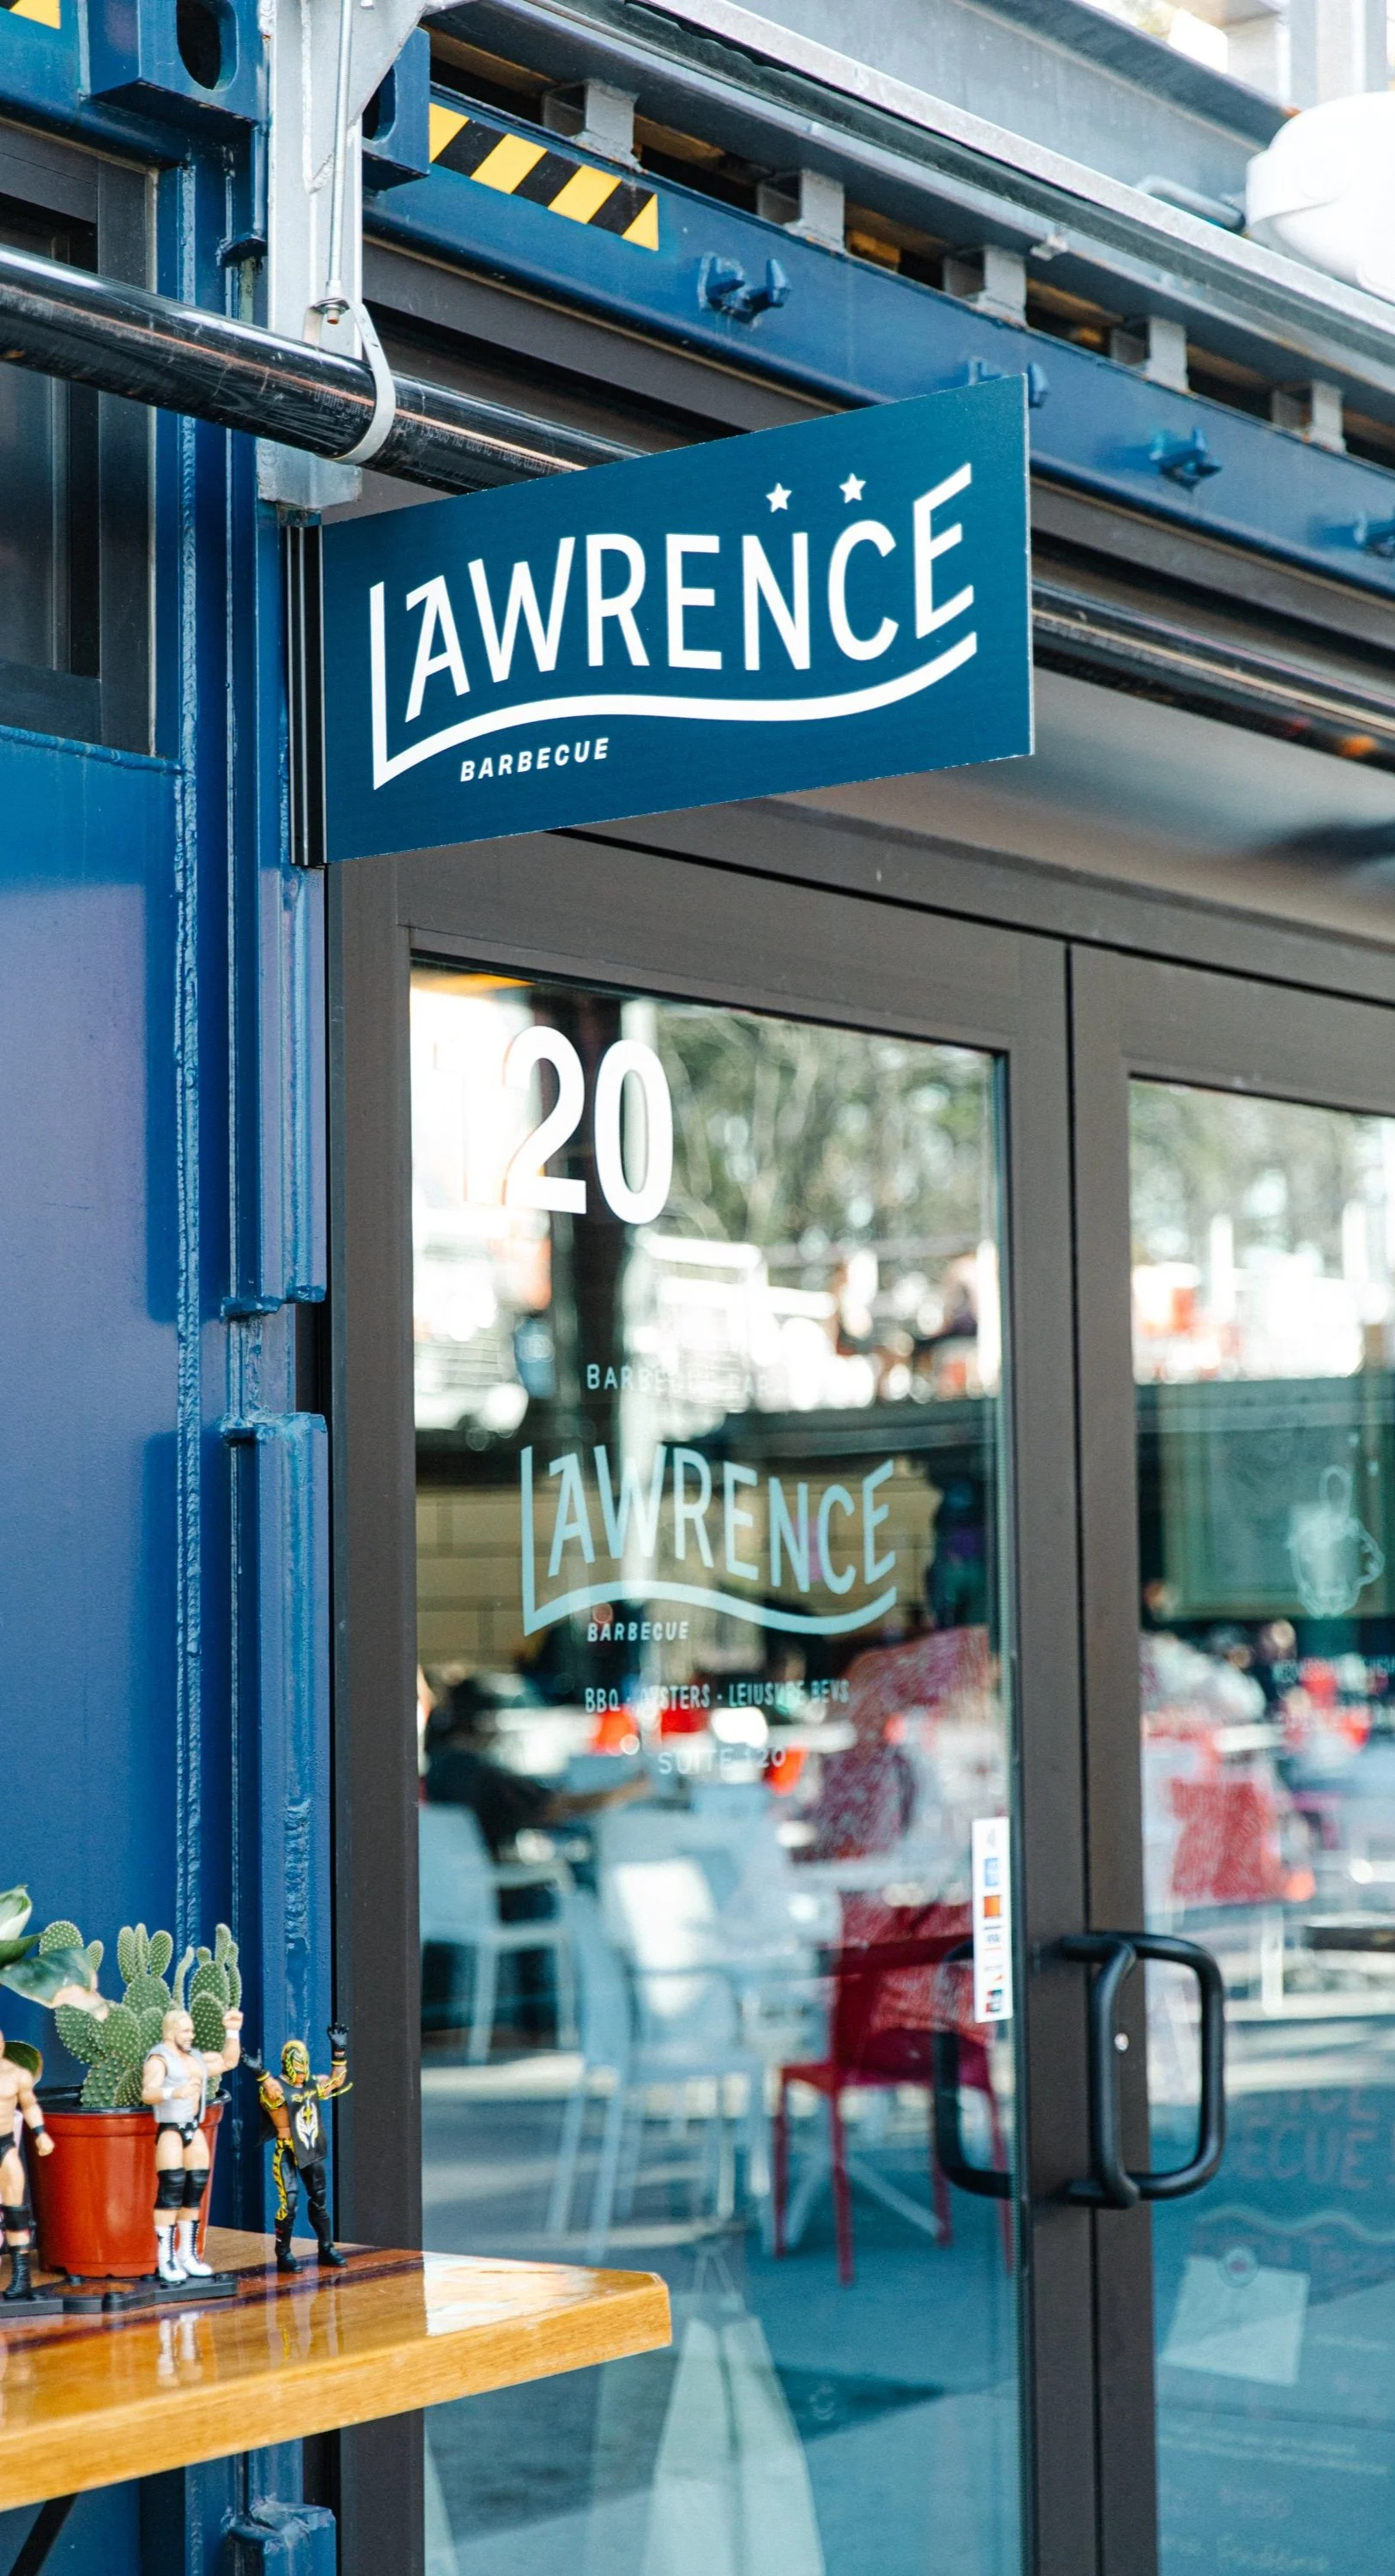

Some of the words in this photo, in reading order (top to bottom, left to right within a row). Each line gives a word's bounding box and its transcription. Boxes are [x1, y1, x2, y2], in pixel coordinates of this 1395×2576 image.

[370, 463, 977, 790] LAWRENCE
[459, 737, 610, 783] BARBECUE
[434, 1024, 673, 1225] 20
[520, 1444, 897, 1637] LAWRENCE
[587, 1620, 689, 1643] BARBECUE
[585, 1686, 621, 1713] BBQ
